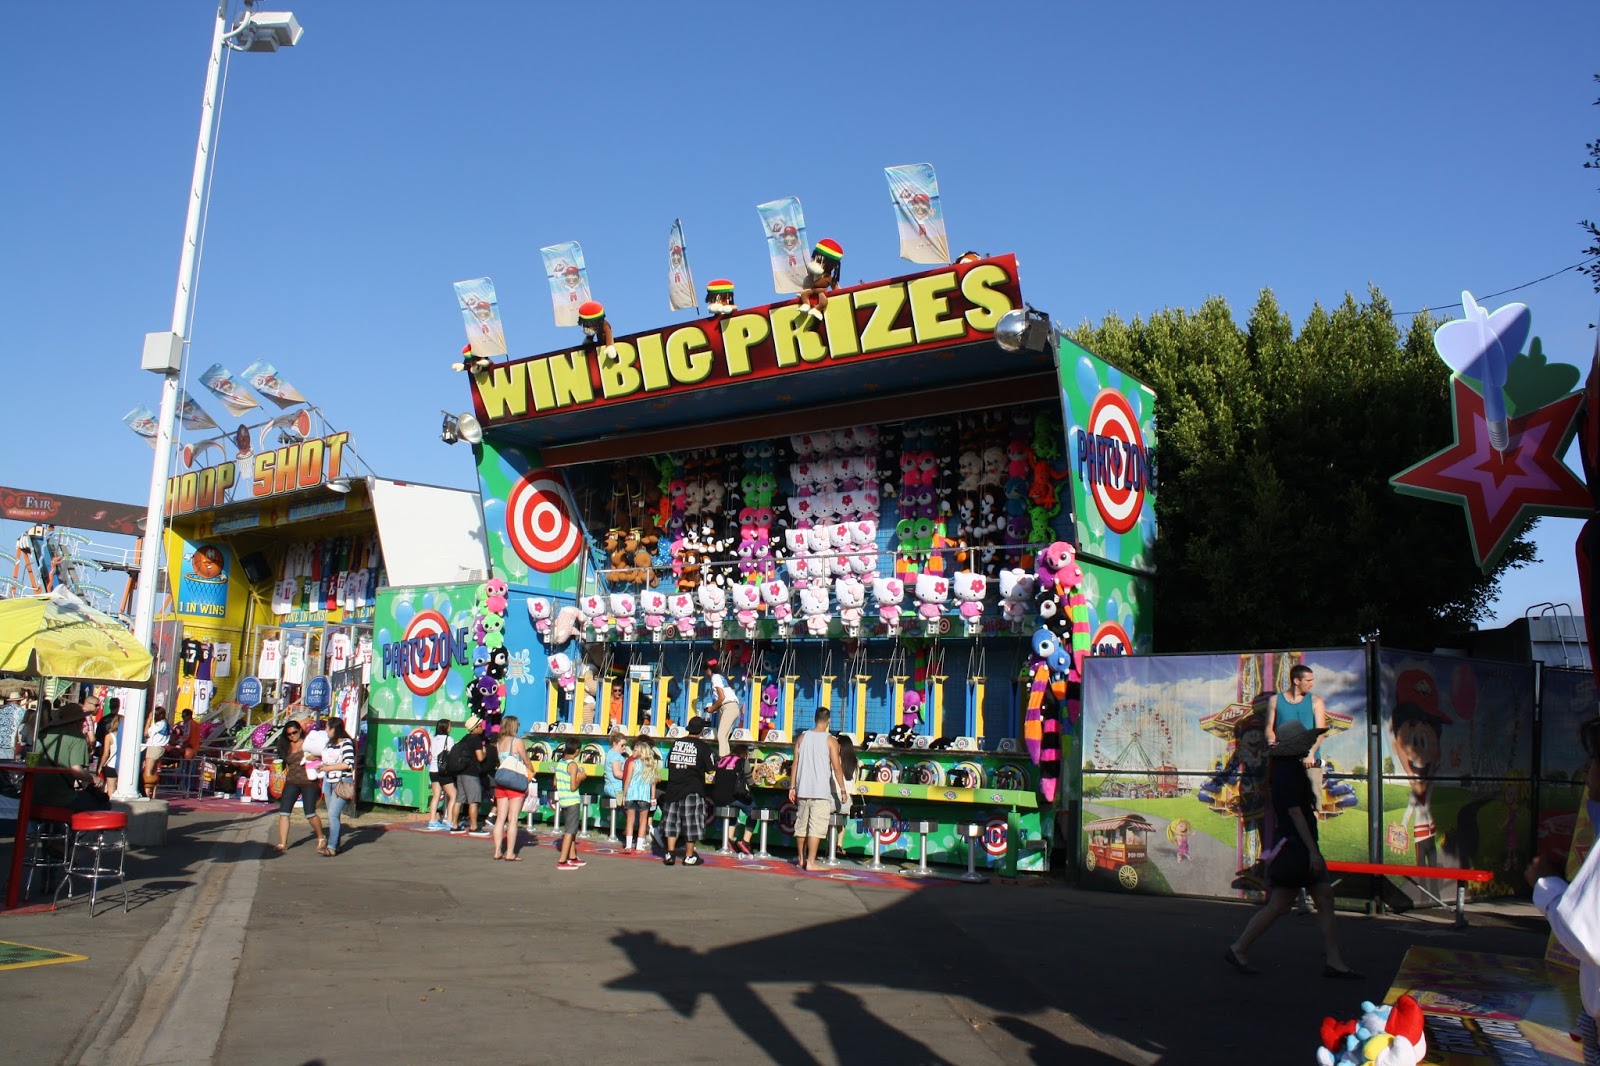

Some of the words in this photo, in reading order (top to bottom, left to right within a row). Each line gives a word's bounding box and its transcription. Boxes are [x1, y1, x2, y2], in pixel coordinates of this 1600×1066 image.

[474, 350, 594, 420] WIN
[598, 326, 714, 400] BIG
[720, 263, 1015, 377] PRIZES
[165, 461, 236, 517] HOOP
[252, 430, 350, 498] SHOT
[1077, 428, 1119, 489] PARTY
[186, 602, 197, 613] IN
[200, 603, 225, 616] WINS
[300, 611, 308, 622] IN
[335, 646, 344, 661] 11
[382, 635, 426, 679] PARTY
[428, 626, 469, 670] ZONE
[199, 687, 206, 701] 6
